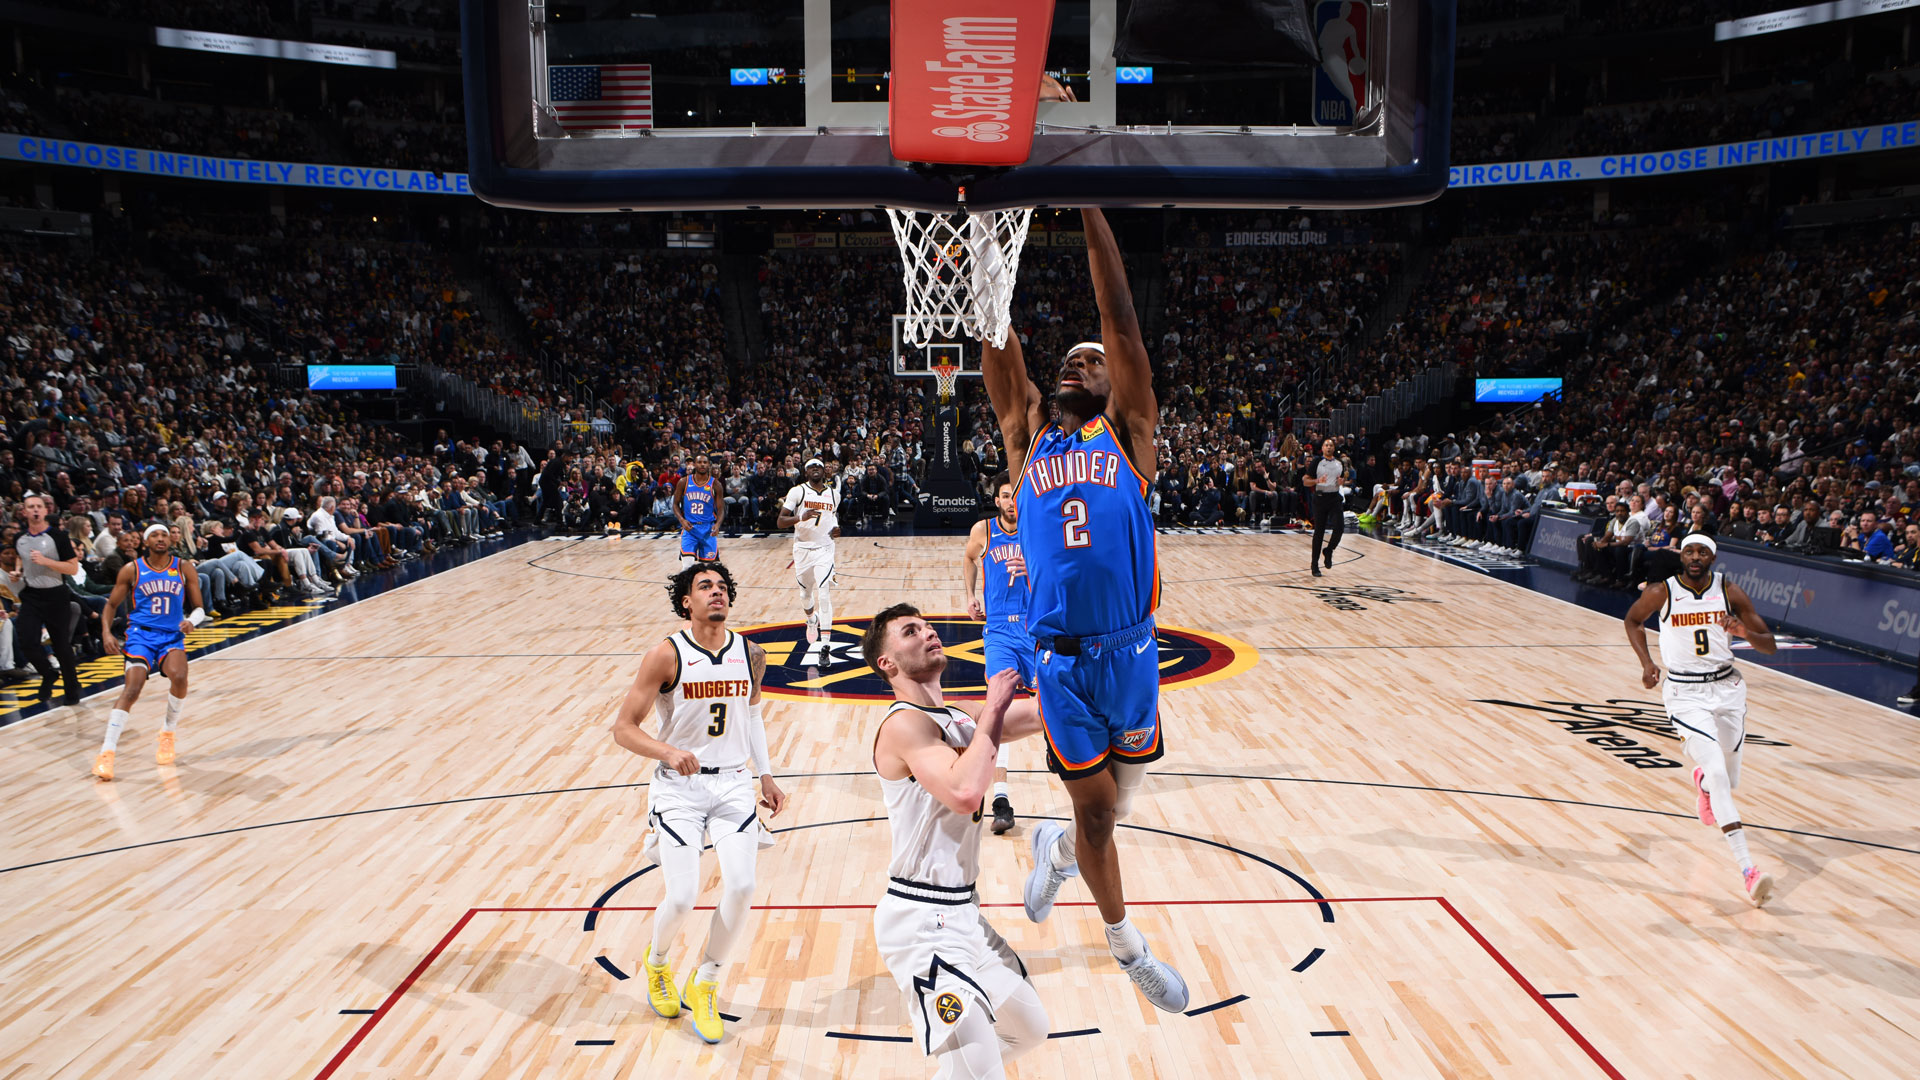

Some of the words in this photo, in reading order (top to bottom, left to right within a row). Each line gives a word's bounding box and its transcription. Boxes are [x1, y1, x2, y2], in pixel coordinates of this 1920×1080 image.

[1321, 100, 1346, 120] NBA
[18, 137, 139, 170] CHOOSE
[149, 151, 293, 183] INFINITELY
[305, 165, 469, 192] RECYCLABLE
[1449, 160, 1581, 185] CIRCULAR.
[1601, 147, 1708, 176] CHOOSE
[1718, 128, 1869, 166] INFINITELY
[844, 232, 879, 246] Coors
[943, 421, 951, 463] Southwest
[1027, 450, 1120, 498] THUNDER
[686, 492, 711, 503] THUNDER
[803, 501, 833, 511] NUGGETS
[932, 496, 976, 506] Fanatics
[691, 502, 704, 515] 22
[1061, 498, 1091, 549] 2
[1538, 528, 1578, 552] Southwes
[1007, 566, 1018, 587] 7
[139, 580, 182, 597] THUNDER
[151, 596, 171, 615] 21
[1008, 615, 1020, 623] OKC
[1694, 629, 1710, 656] 9
[682, 680, 749, 699] NUGGETS
[708, 703, 727, 737] 3
[1124, 732, 1145, 744] OKC
[1547, 718, 1684, 769] Arena
